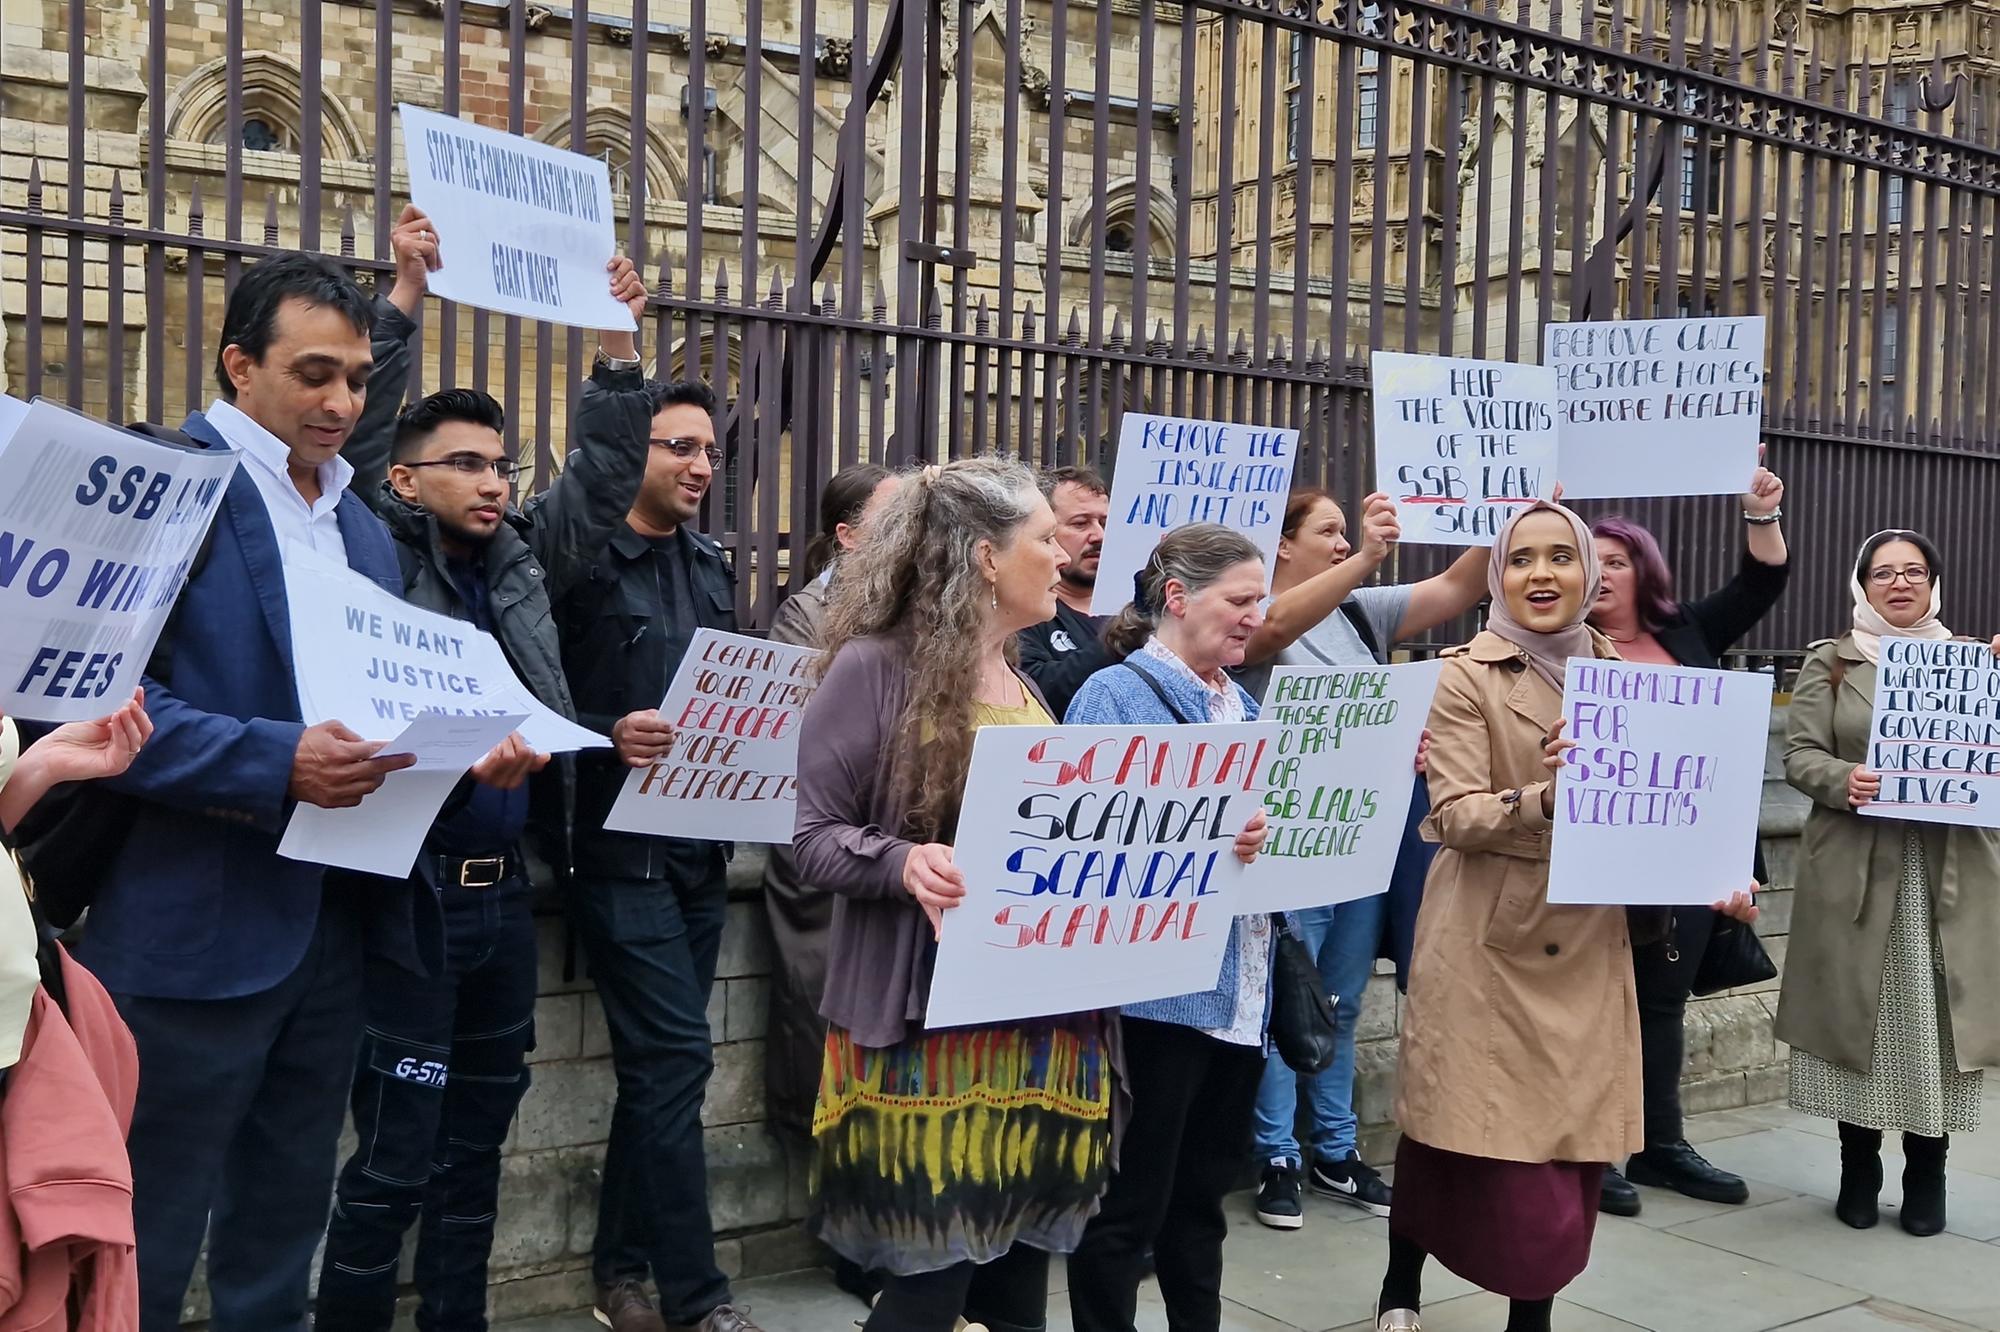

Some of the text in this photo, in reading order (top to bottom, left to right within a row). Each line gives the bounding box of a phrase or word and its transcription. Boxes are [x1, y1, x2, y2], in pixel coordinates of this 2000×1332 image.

[426, 127, 600, 224] STOP THE COWBOYS WASTING YOUR
[491, 242, 563, 308] GRANT MONEY
[1552, 323, 1743, 358] REMOVE CWI
[1556, 359, 1760, 392] RESTORE HOMES
[1395, 398, 1552, 431] THE VICTIMS
[1664, 390, 1759, 420] HEALTH
[1142, 419, 1288, 457] REMOVE THE
[1436, 433, 1518, 459] OF THE
[75, 455, 171, 520] SSB
[1146, 459, 1290, 494] INSULATION
[1398, 465, 1541, 499] SSB LAW
[1126, 493, 1179, 528] AND
[1240, 499, 1271, 528] US
[0, 531, 70, 598] NO
[345, 605, 464, 659] WE WANT
[16, 647, 124, 698] FEES
[702, 640, 784, 675] LEARN
[366, 657, 483, 696] JUSTICE
[693, 665, 754, 701] YOUR
[1275, 672, 1391, 703] REIMBURSE
[1572, 665, 1723, 706] INDEMNITY
[1884, 667, 1979, 692] WANTED
[371, 697, 415, 722] WE
[677, 697, 795, 740] BEFORE
[1270, 700, 1399, 728] THOSE FORCED
[1881, 690, 2000, 721] INSULAT
[1299, 727, 1344, 755] PAY
[1573, 702, 1630, 747] FOR
[1879, 713, 2000, 745] GOVERNM
[661, 731, 746, 767] MORE
[1023, 735, 1267, 792] SCANDAL
[1874, 742, 2000, 775] WRECKE
[1268, 757, 1301, 789] OR
[1566, 747, 1719, 792] SSB LAW
[1263, 786, 1379, 823] SB LAWS
[1872, 774, 1979, 804] LIVES
[1009, 790, 1236, 846] SCANDAL
[1567, 787, 1698, 827] VICTIMS
[1259, 824, 1363, 858] GLIGENCE
[995, 846, 1220, 899] SCANDAL
[984, 901, 1208, 949] SCANDAL
[396, 1057, 448, 1086] G-STA
